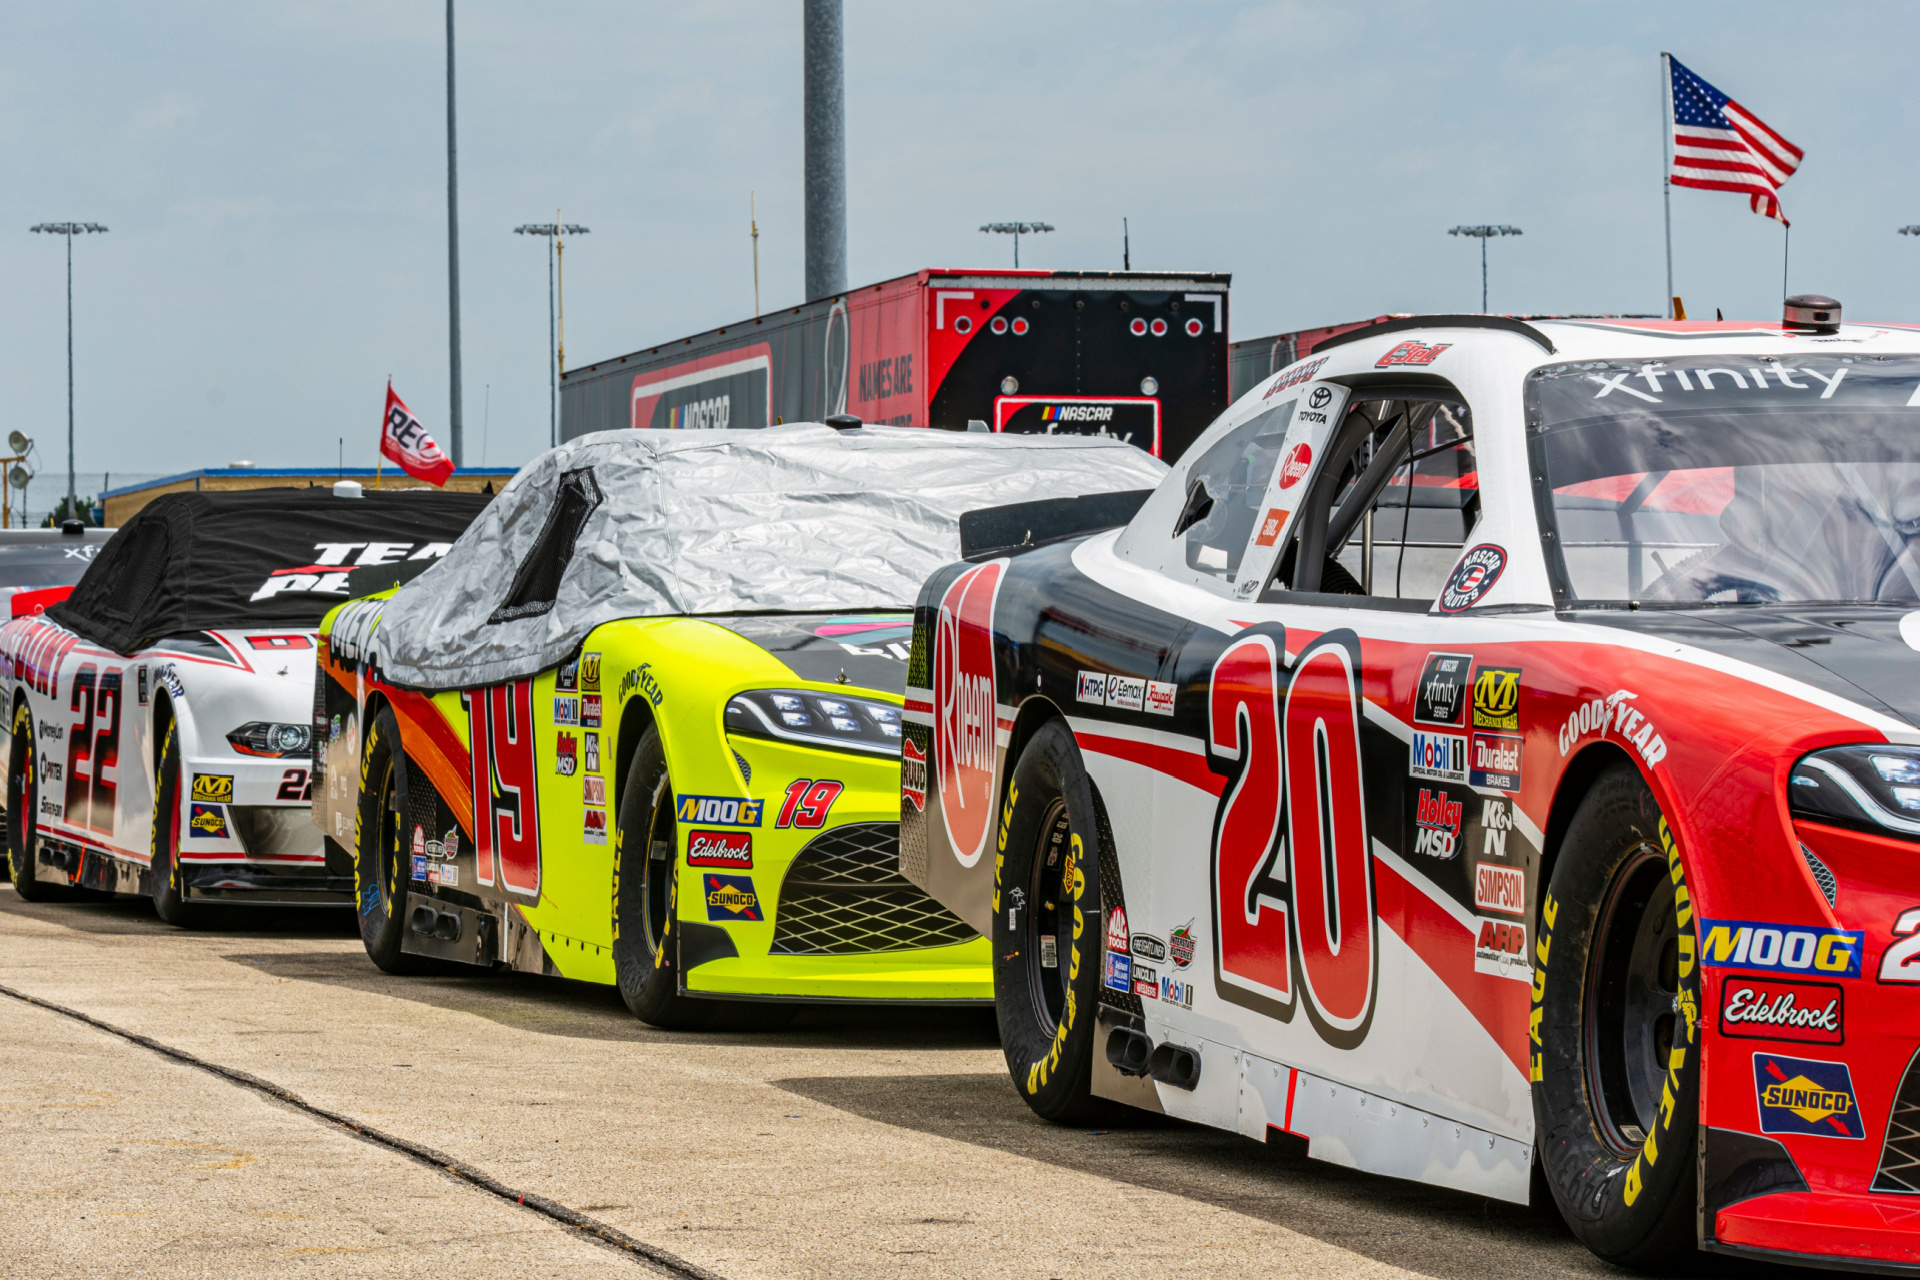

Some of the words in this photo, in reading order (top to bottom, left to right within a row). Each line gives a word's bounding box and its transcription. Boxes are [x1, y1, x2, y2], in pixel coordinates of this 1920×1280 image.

[859, 357, 892, 402] NAMES
[893, 354, 913, 394] ARE
[1587, 362, 1849, 403] xfinity
[1059, 406, 1113, 421] NASCAR
[1298, 411, 1327, 425] TOYOTA
[1281, 445, 1309, 482] Rheem
[1263, 519, 1279, 537] JBL
[314, 542, 454, 566] TEA
[1463, 550, 1501, 574] NASCAR
[1444, 584, 1479, 607] SALUTES
[618, 668, 663, 710] GOODYEAR
[1084, 679, 1104, 698] HTPG
[1118, 680, 1143, 701] Eemax
[1424, 674, 1459, 712] xfinity
[554, 698, 571, 719] Mobil
[940, 602, 994, 810] Rheem
[1433, 706, 1449, 719] SERIES
[1473, 708, 1502, 728] MECHANIX
[1502, 712, 1518, 730] WEAR
[557, 731, 577, 761] Holley
[1559, 696, 1667, 771] GOODYEAR
[63, 661, 123, 837] 22
[1413, 733, 1450, 770] Mobil
[1454, 740, 1463, 770] 1
[1475, 740, 1519, 771] Duralast
[555, 757, 575, 776] MSD
[903, 758, 926, 791] RUUD
[1413, 767, 1426, 775] OFFICIAL
[1486, 773, 1511, 787] BRAKES
[462, 677, 541, 902] 19
[678, 798, 761, 824] MOOG
[775, 778, 844, 829] 19
[1416, 788, 1462, 837] Holley
[194, 817, 225, 828] SUNOCO
[584, 810, 606, 830] ARP
[1207, 627, 1376, 1040] 20
[690, 837, 750, 861] Edelbrock
[993, 767, 1018, 914] EAGLE
[1415, 827, 1456, 859] MSD
[611, 828, 624, 942] EAGLE
[1478, 868, 1522, 909] SIMPSON
[710, 893, 754, 905] SUNOCO
[1109, 936, 1127, 950] TOOLS
[1133, 938, 1164, 958] FREIGHTLINER
[1170, 936, 1196, 951] INTERSTATE
[1477, 920, 1525, 955] ARP
[1702, 926, 1857, 972] MOOG
[1027, 832, 1086, 1096] GOODYEAR
[1170, 946, 1193, 961] BATTERIES
[1476, 950, 1499, 961] automotive
[1510, 957, 1528, 967] products
[1133, 964, 1155, 983] LINCOLN
[1530, 884, 1559, 1082] EAGLE
[1162, 976, 1185, 1003] Mobil
[1626, 814, 1698, 1208] GOODYEAR
[1724, 988, 1838, 1031] Edelbrock
[1767, 1087, 1848, 1112] SUNOCO
